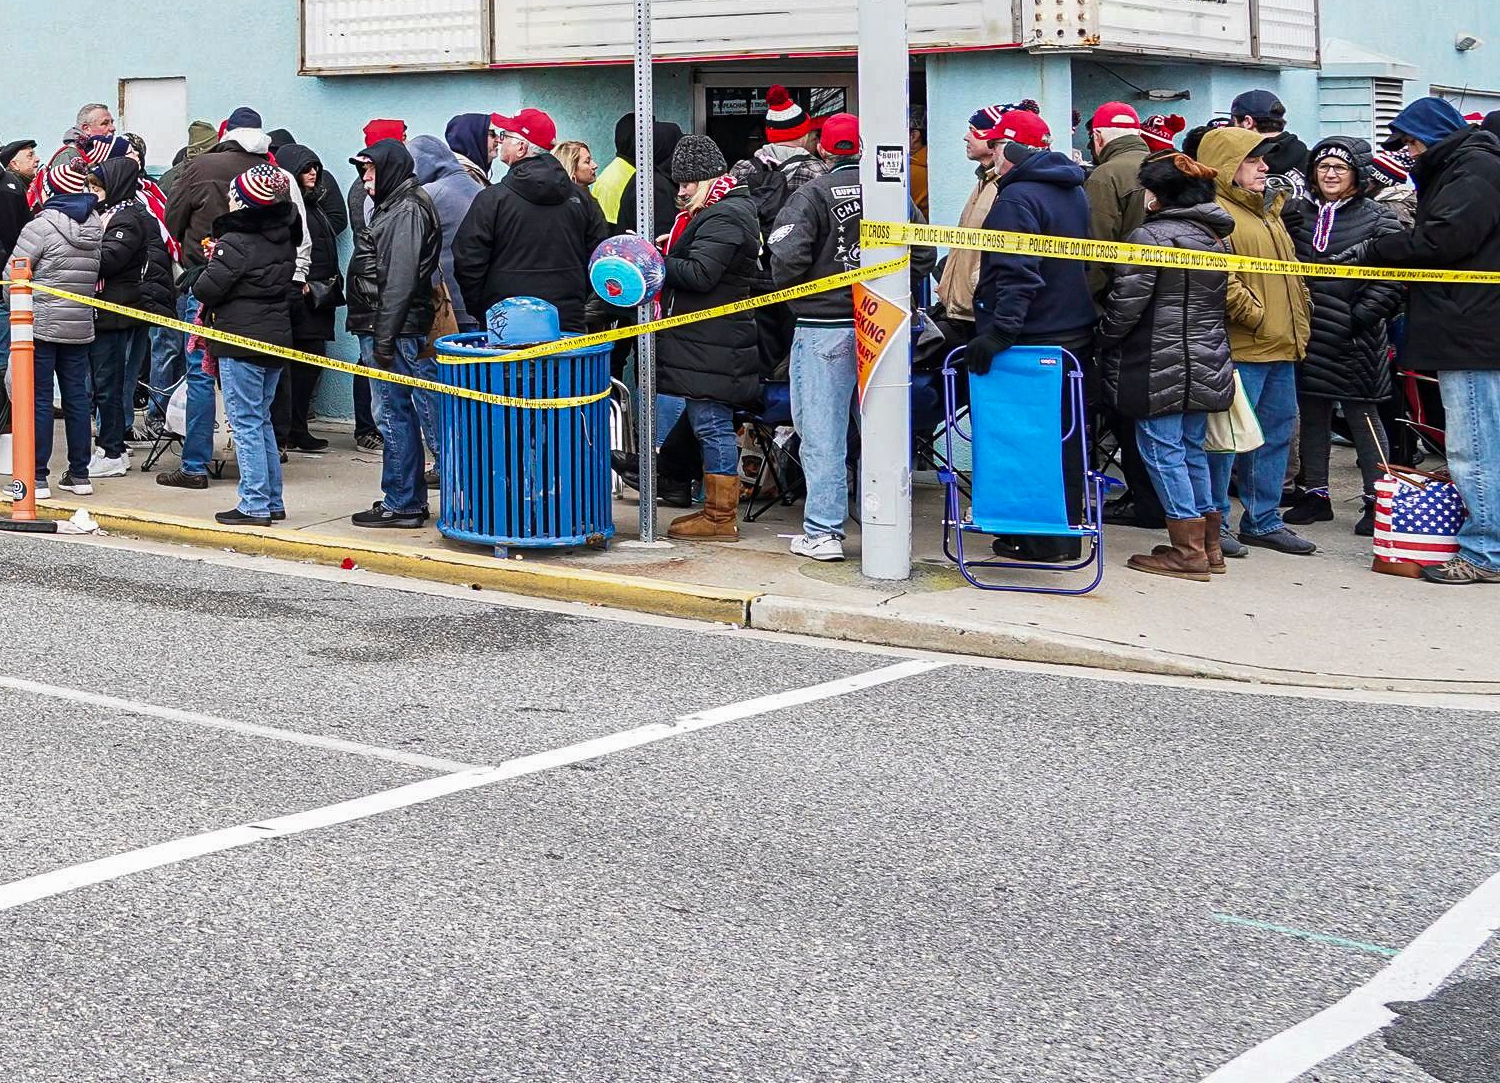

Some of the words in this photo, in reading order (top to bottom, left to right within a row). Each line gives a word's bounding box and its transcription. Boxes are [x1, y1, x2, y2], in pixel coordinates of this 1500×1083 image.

[869, 224, 890, 239] CROSS
[914, 228, 937, 242] POLICE
[939, 231, 955, 243] LINE
[956, 232, 966, 244] DO
[967, 233, 980, 246] NOT
[982, 234, 1005, 248] CROSS
[1028, 238, 1052, 252] POLICE
[1053, 241, 1069, 254] LINE
[1070, 243, 1080, 256] DO
[1081, 244, 1094, 257] NOT
[1095, 246, 1119, 260] CROSS
[1141, 248, 1163, 262] POLICE
[1165, 251, 1180, 264] LINE
[1181, 252, 1191, 265] DO
[1192, 254, 1205, 267] NOT
[1206, 255, 1228, 268] CROSS
[861, 296, 879, 316] NO
